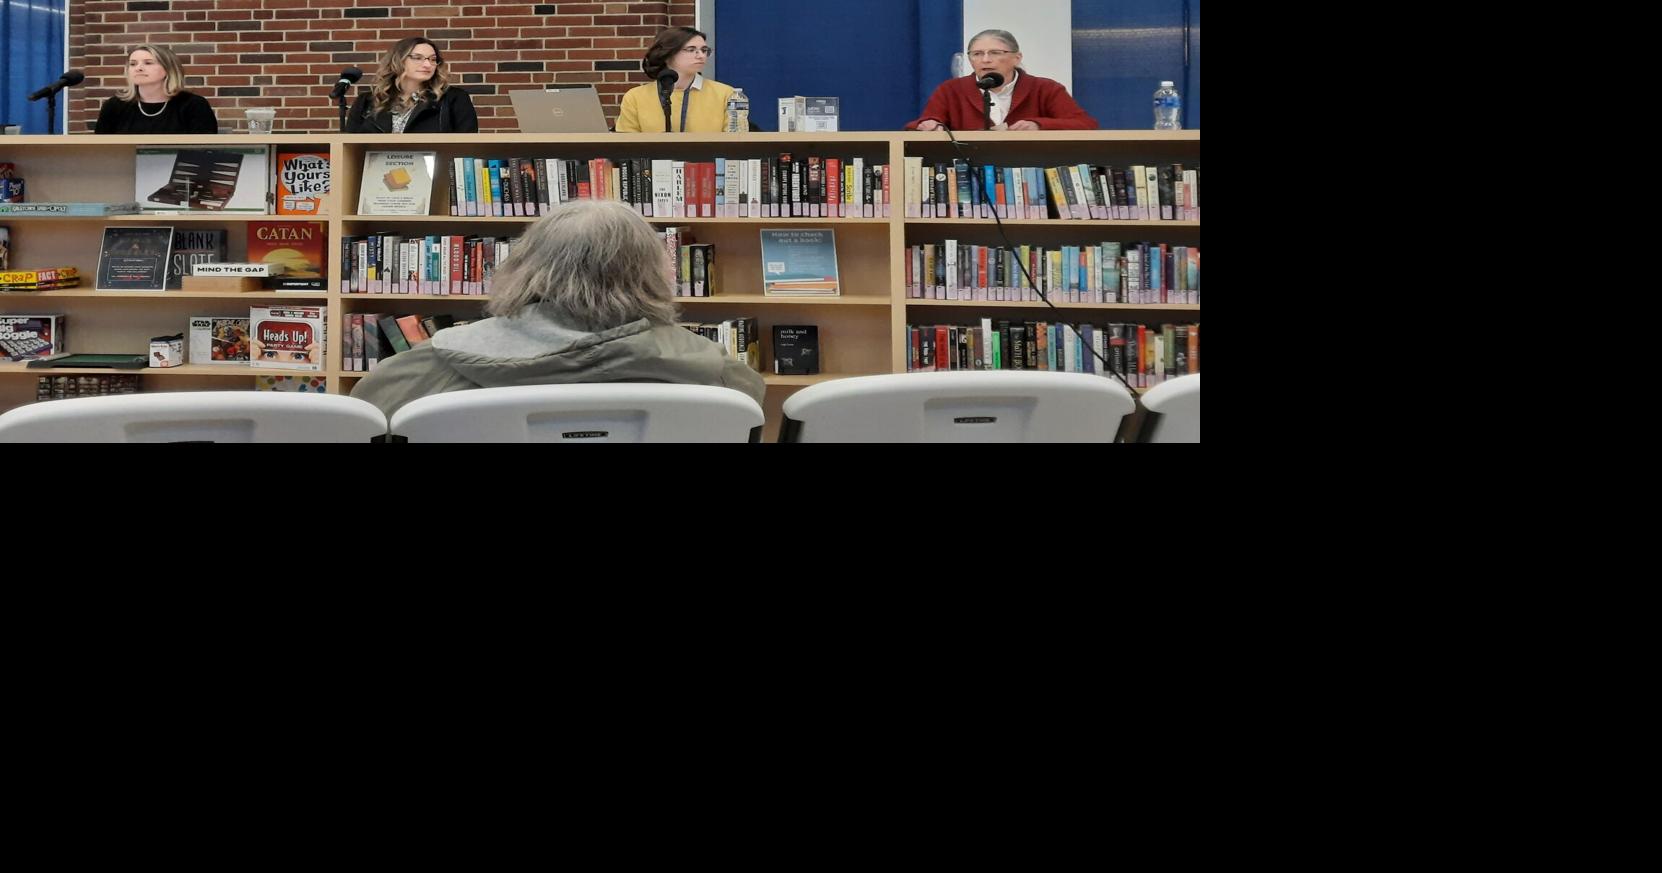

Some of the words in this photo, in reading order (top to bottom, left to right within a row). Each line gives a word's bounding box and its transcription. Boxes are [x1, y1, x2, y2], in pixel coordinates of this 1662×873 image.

[284, 171, 330, 184] Yours
[290, 180, 330, 195] Like?
[256, 227, 312, 240] CATAN
[175, 231, 214, 250] BLANK
[38, 271, 56, 281] FACT
[0, 318, 29, 326] uper
[0, 330, 38, 340] oggle
[263, 329, 289, 342] Heads
[292, 330, 307, 345] Up!
